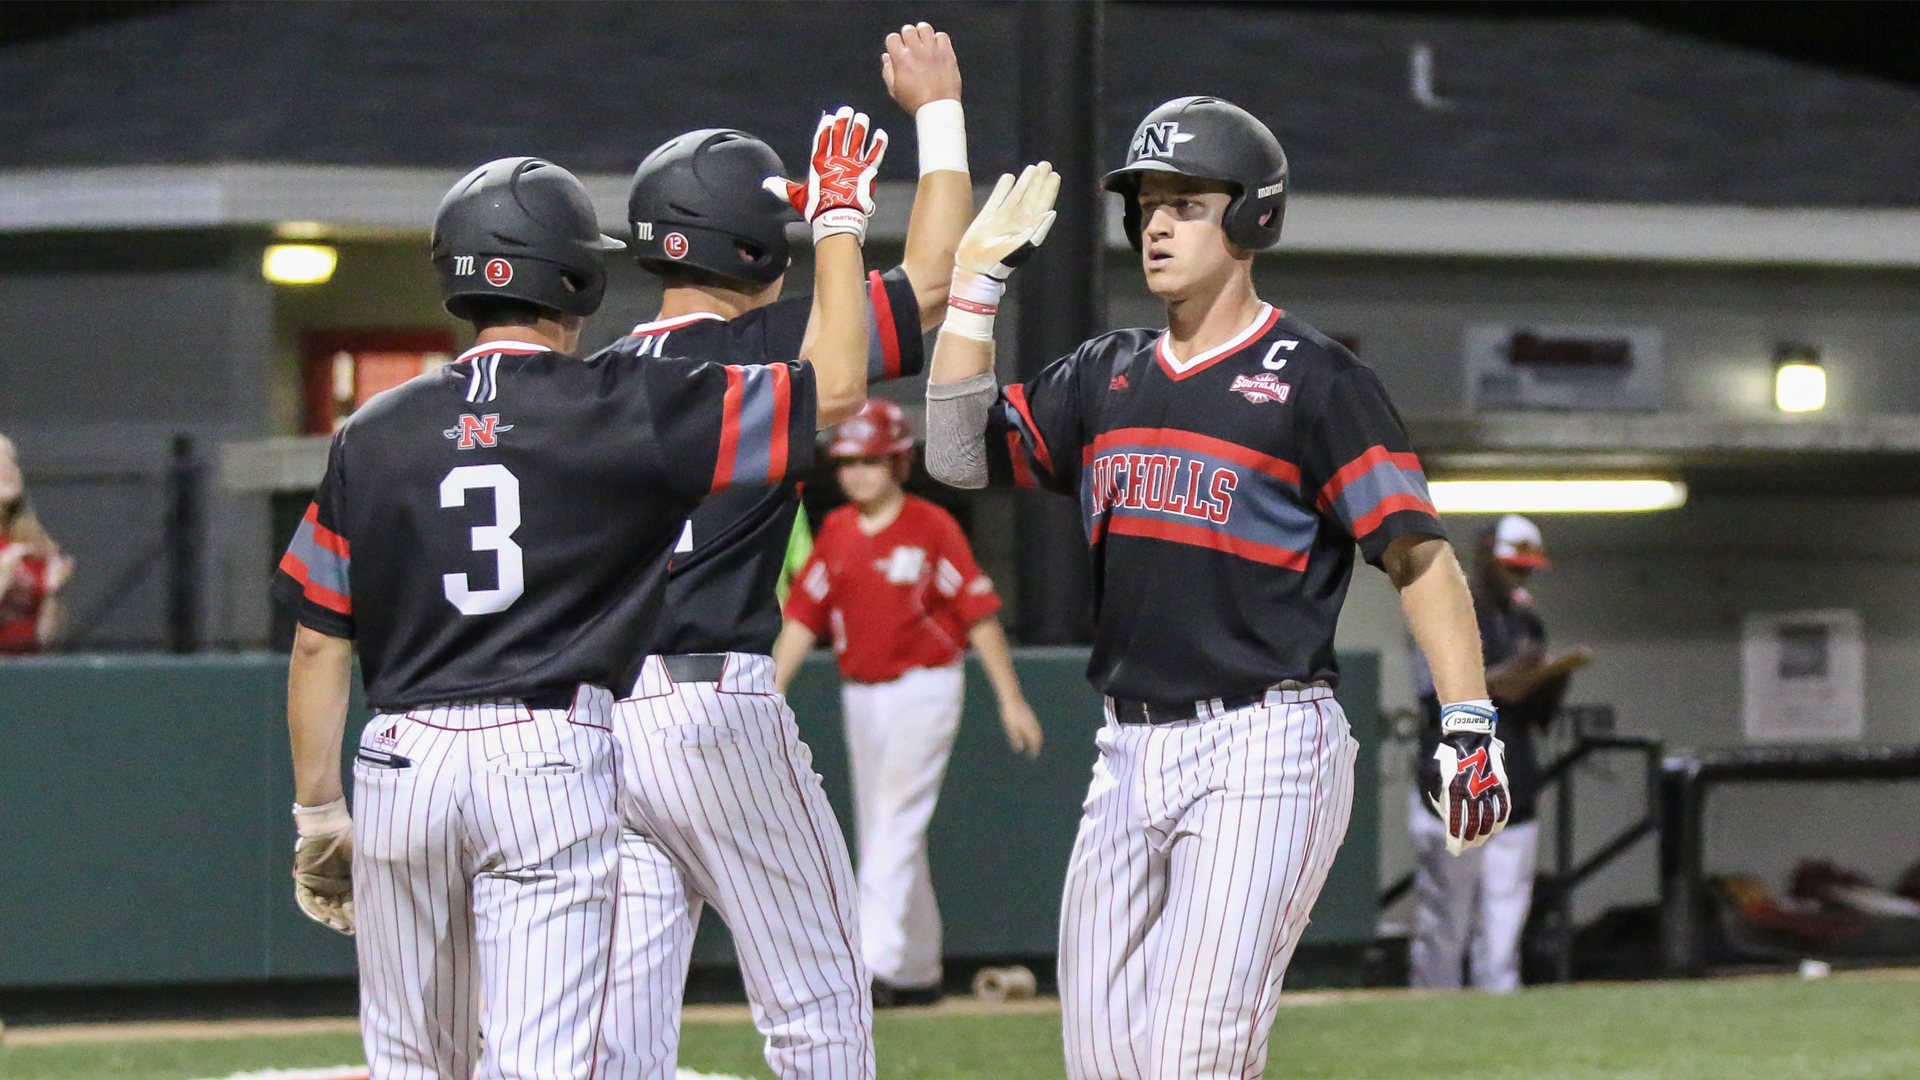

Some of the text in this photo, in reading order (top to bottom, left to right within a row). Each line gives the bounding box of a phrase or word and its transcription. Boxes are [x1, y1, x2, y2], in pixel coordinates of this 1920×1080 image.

[1139, 121, 1179, 159] N
[669, 236, 682, 250] 12
[493, 262, 503, 277] 3
[1262, 339, 1299, 370] C
[1232, 375, 1291, 401] SOUTHLAND
[458, 413, 500, 449] N
[1092, 453, 1239, 525] NICHOLLS
[439, 464, 525, 615] 3
[1453, 717, 1487, 726] marucci
